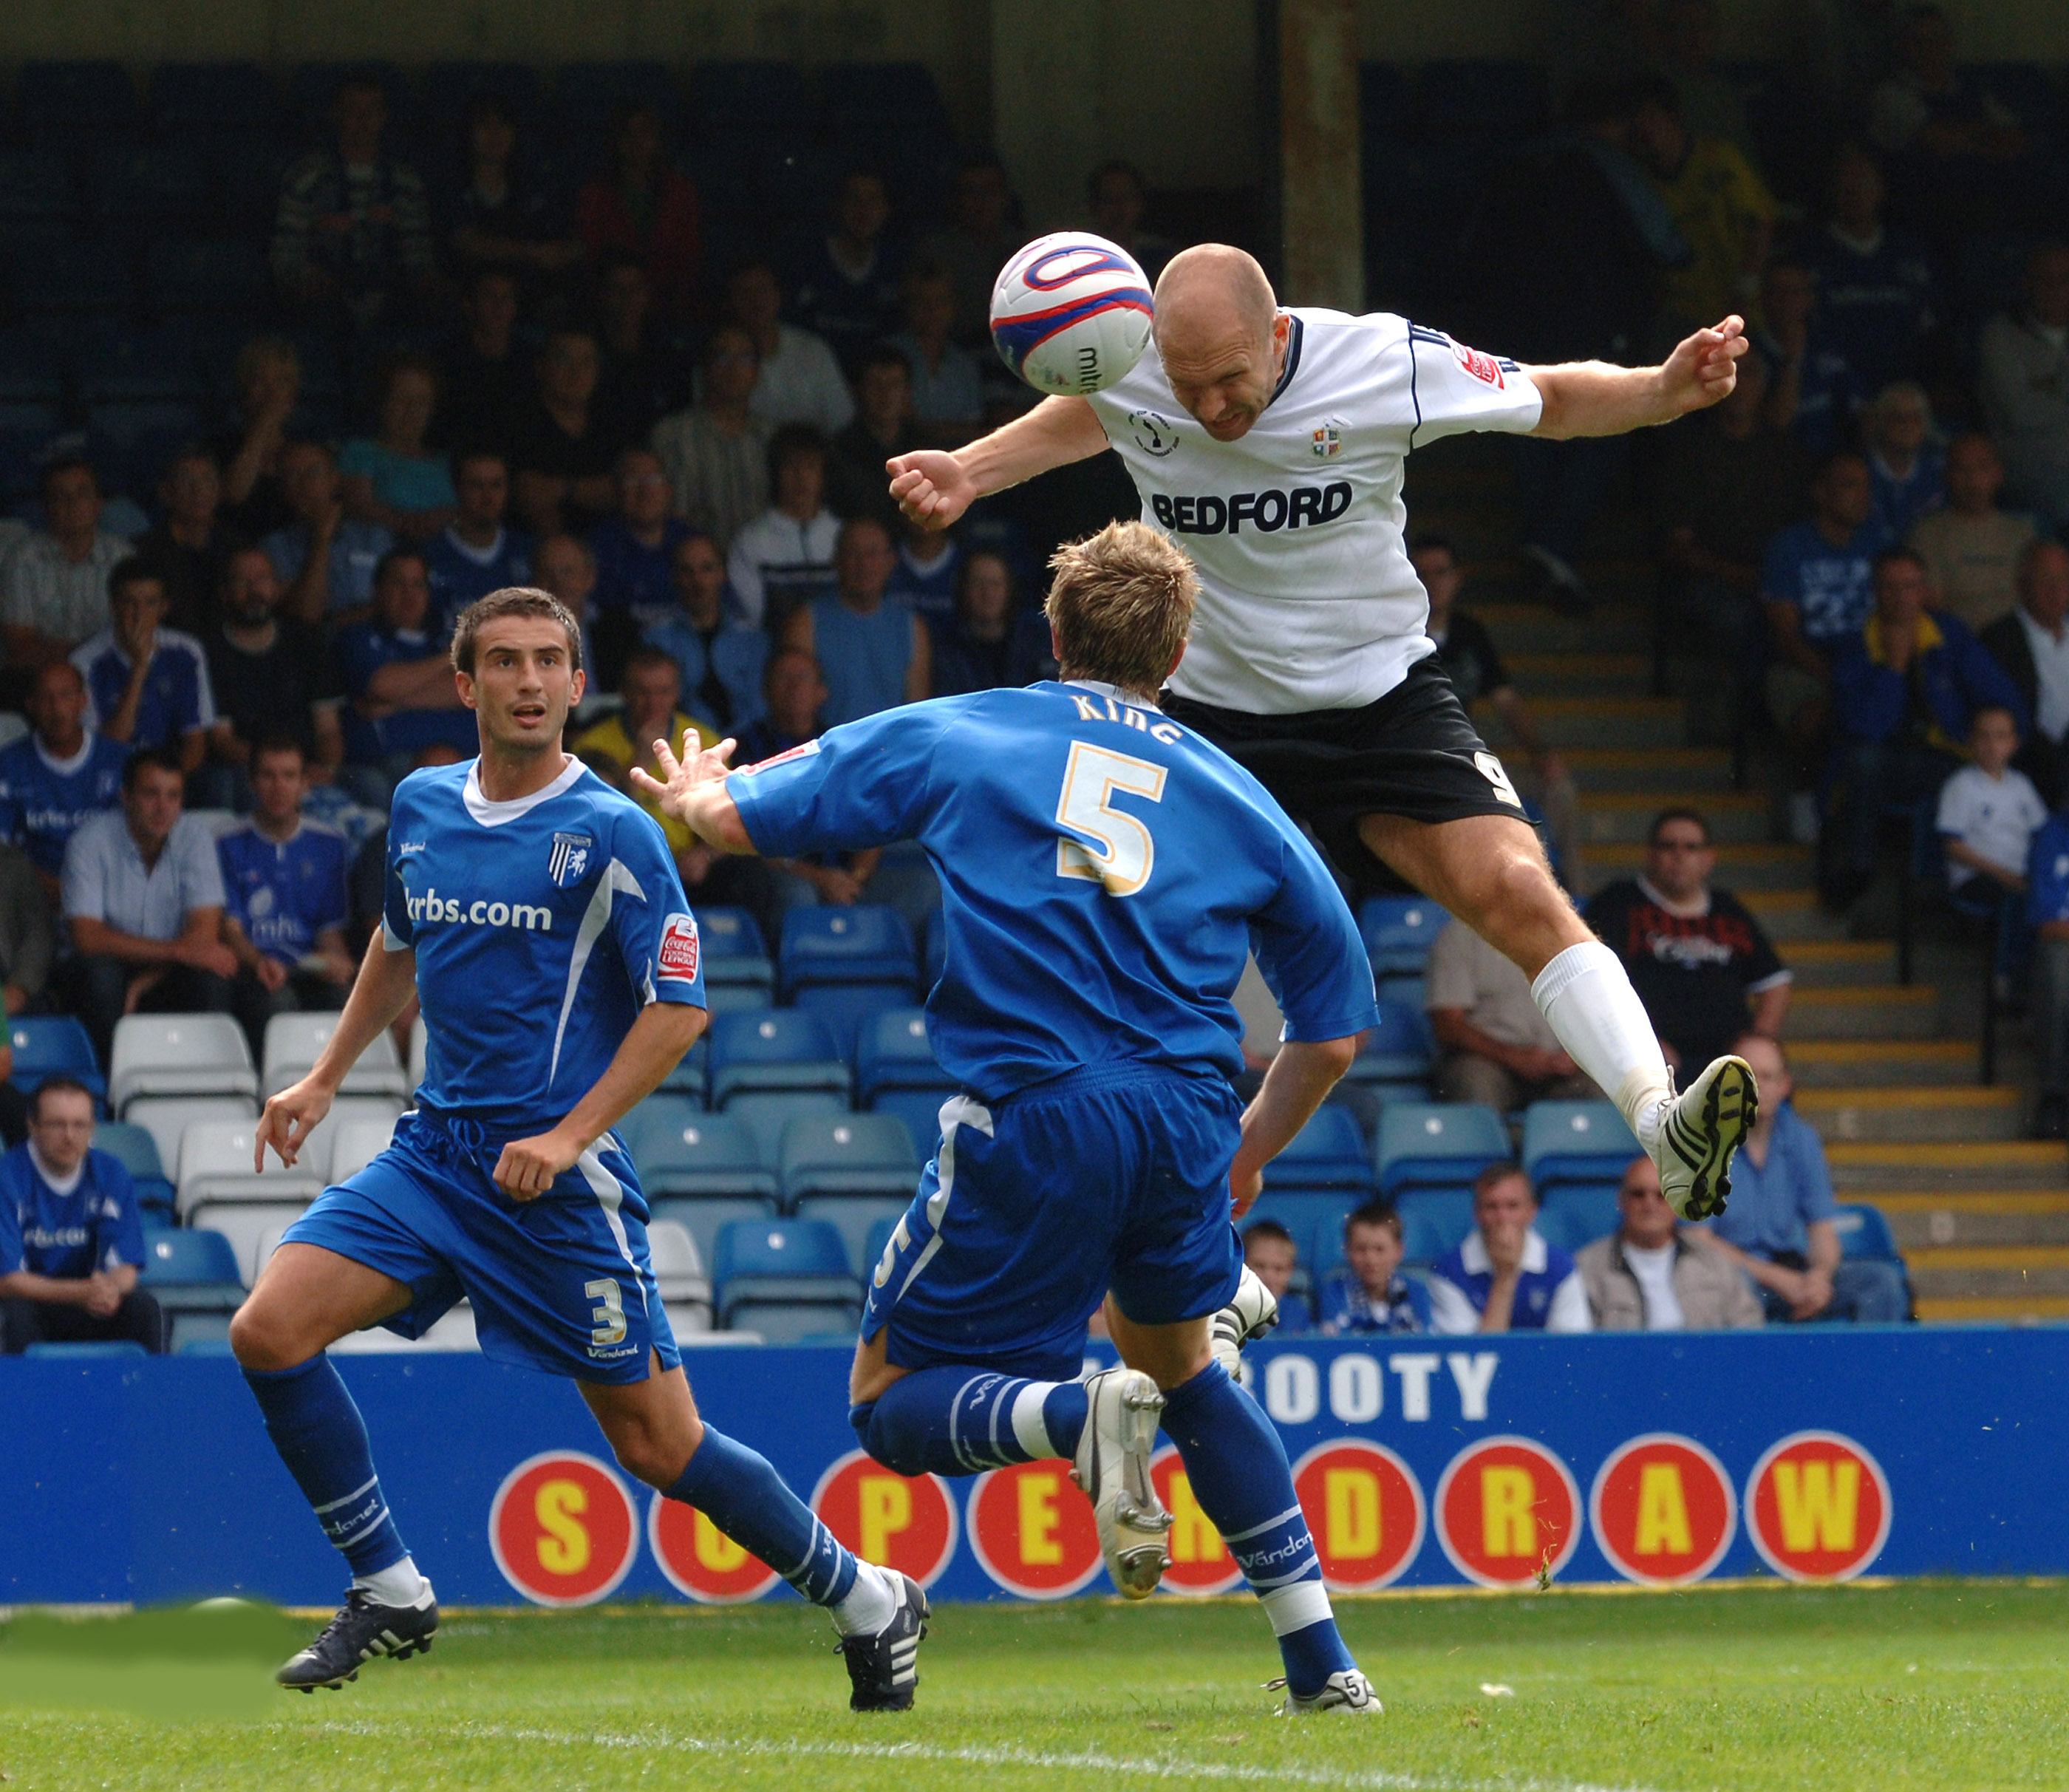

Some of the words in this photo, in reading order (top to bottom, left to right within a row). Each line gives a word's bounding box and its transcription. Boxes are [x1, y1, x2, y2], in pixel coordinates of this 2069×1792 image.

[1151, 481, 1352, 535] BEDFORD
[1474, 751, 1522, 808] 9
[1055, 740, 1169, 897] 5
[406, 887, 552, 930] krbs.com
[584, 1278, 627, 1346] 3
[1238, 1354, 1498, 1423] OOTY
[1344, 1675, 1360, 1697] 5
